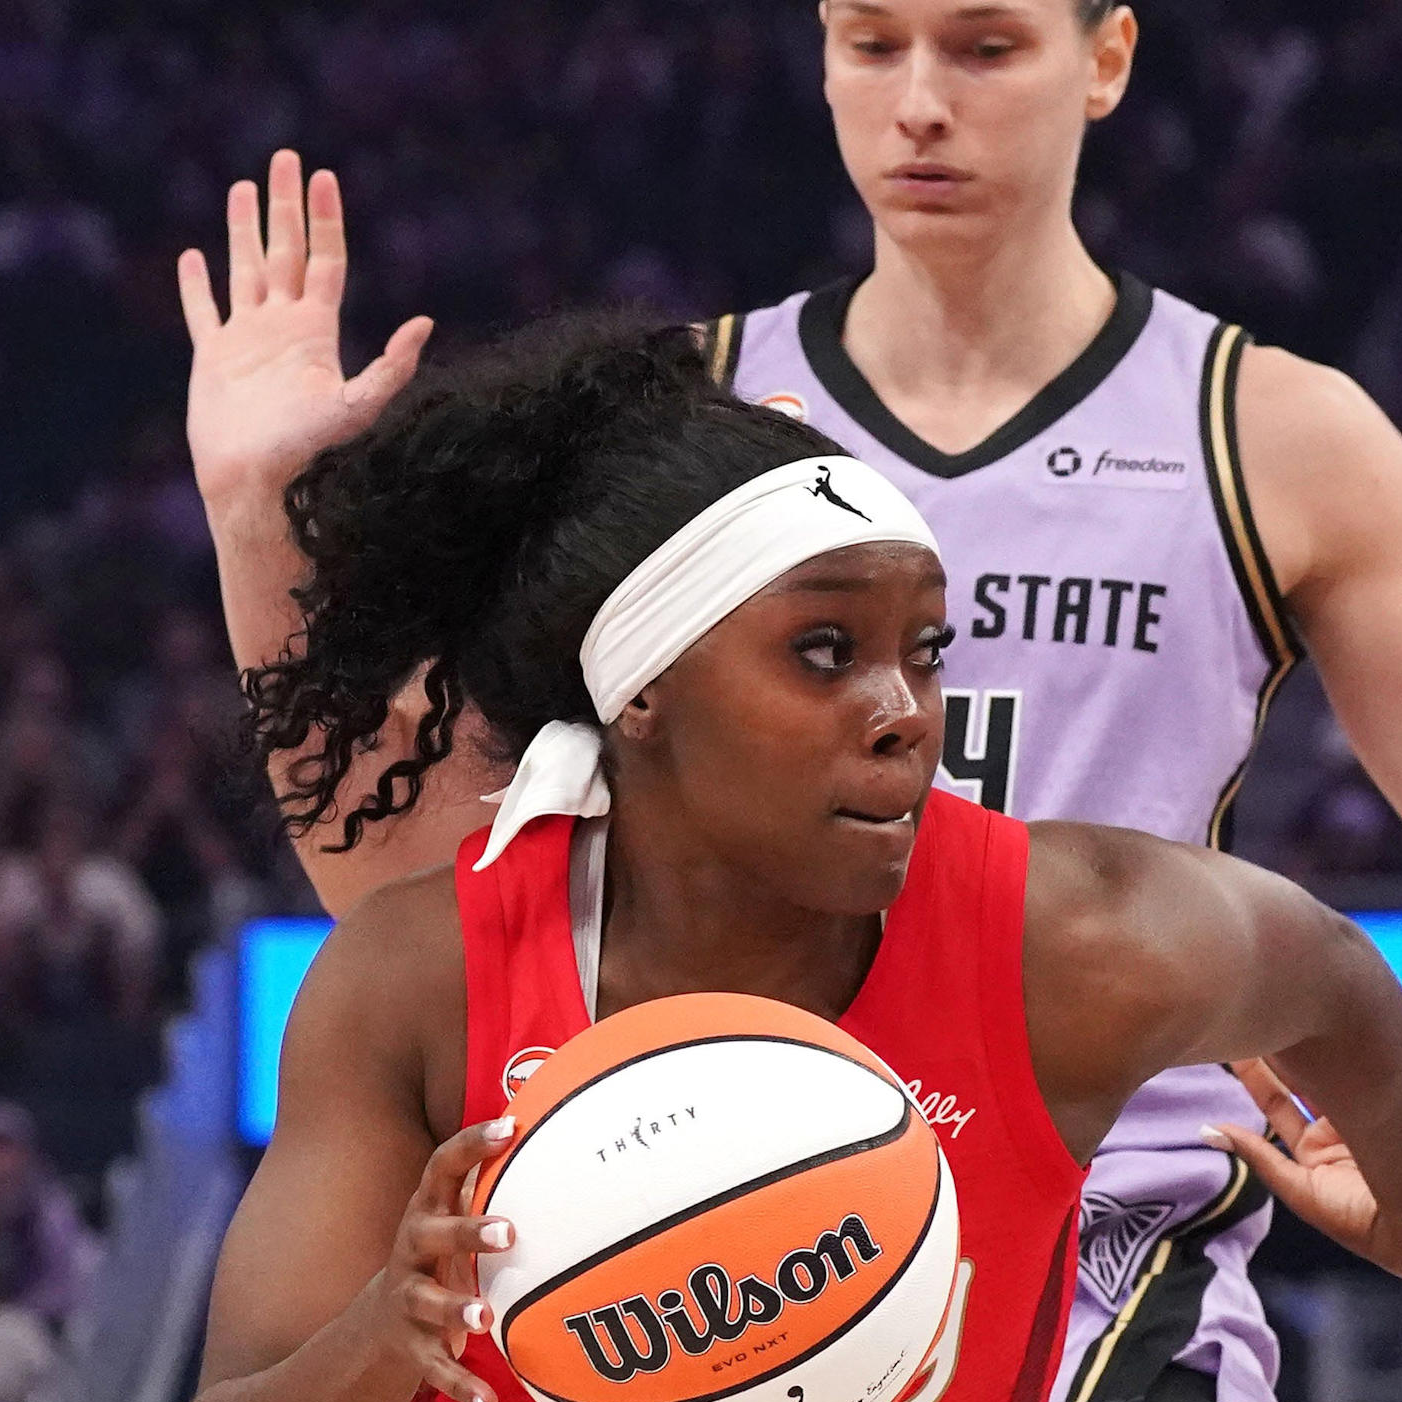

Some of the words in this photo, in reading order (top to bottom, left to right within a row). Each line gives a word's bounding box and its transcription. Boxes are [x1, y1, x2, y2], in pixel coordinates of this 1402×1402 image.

[1092, 449, 1186, 476] freedom
[971, 573, 1167, 653] STATE
[563, 1213, 884, 1384] Wilson
[711, 1351, 747, 1373] EVO
[752, 1331, 790, 1356] NXT
